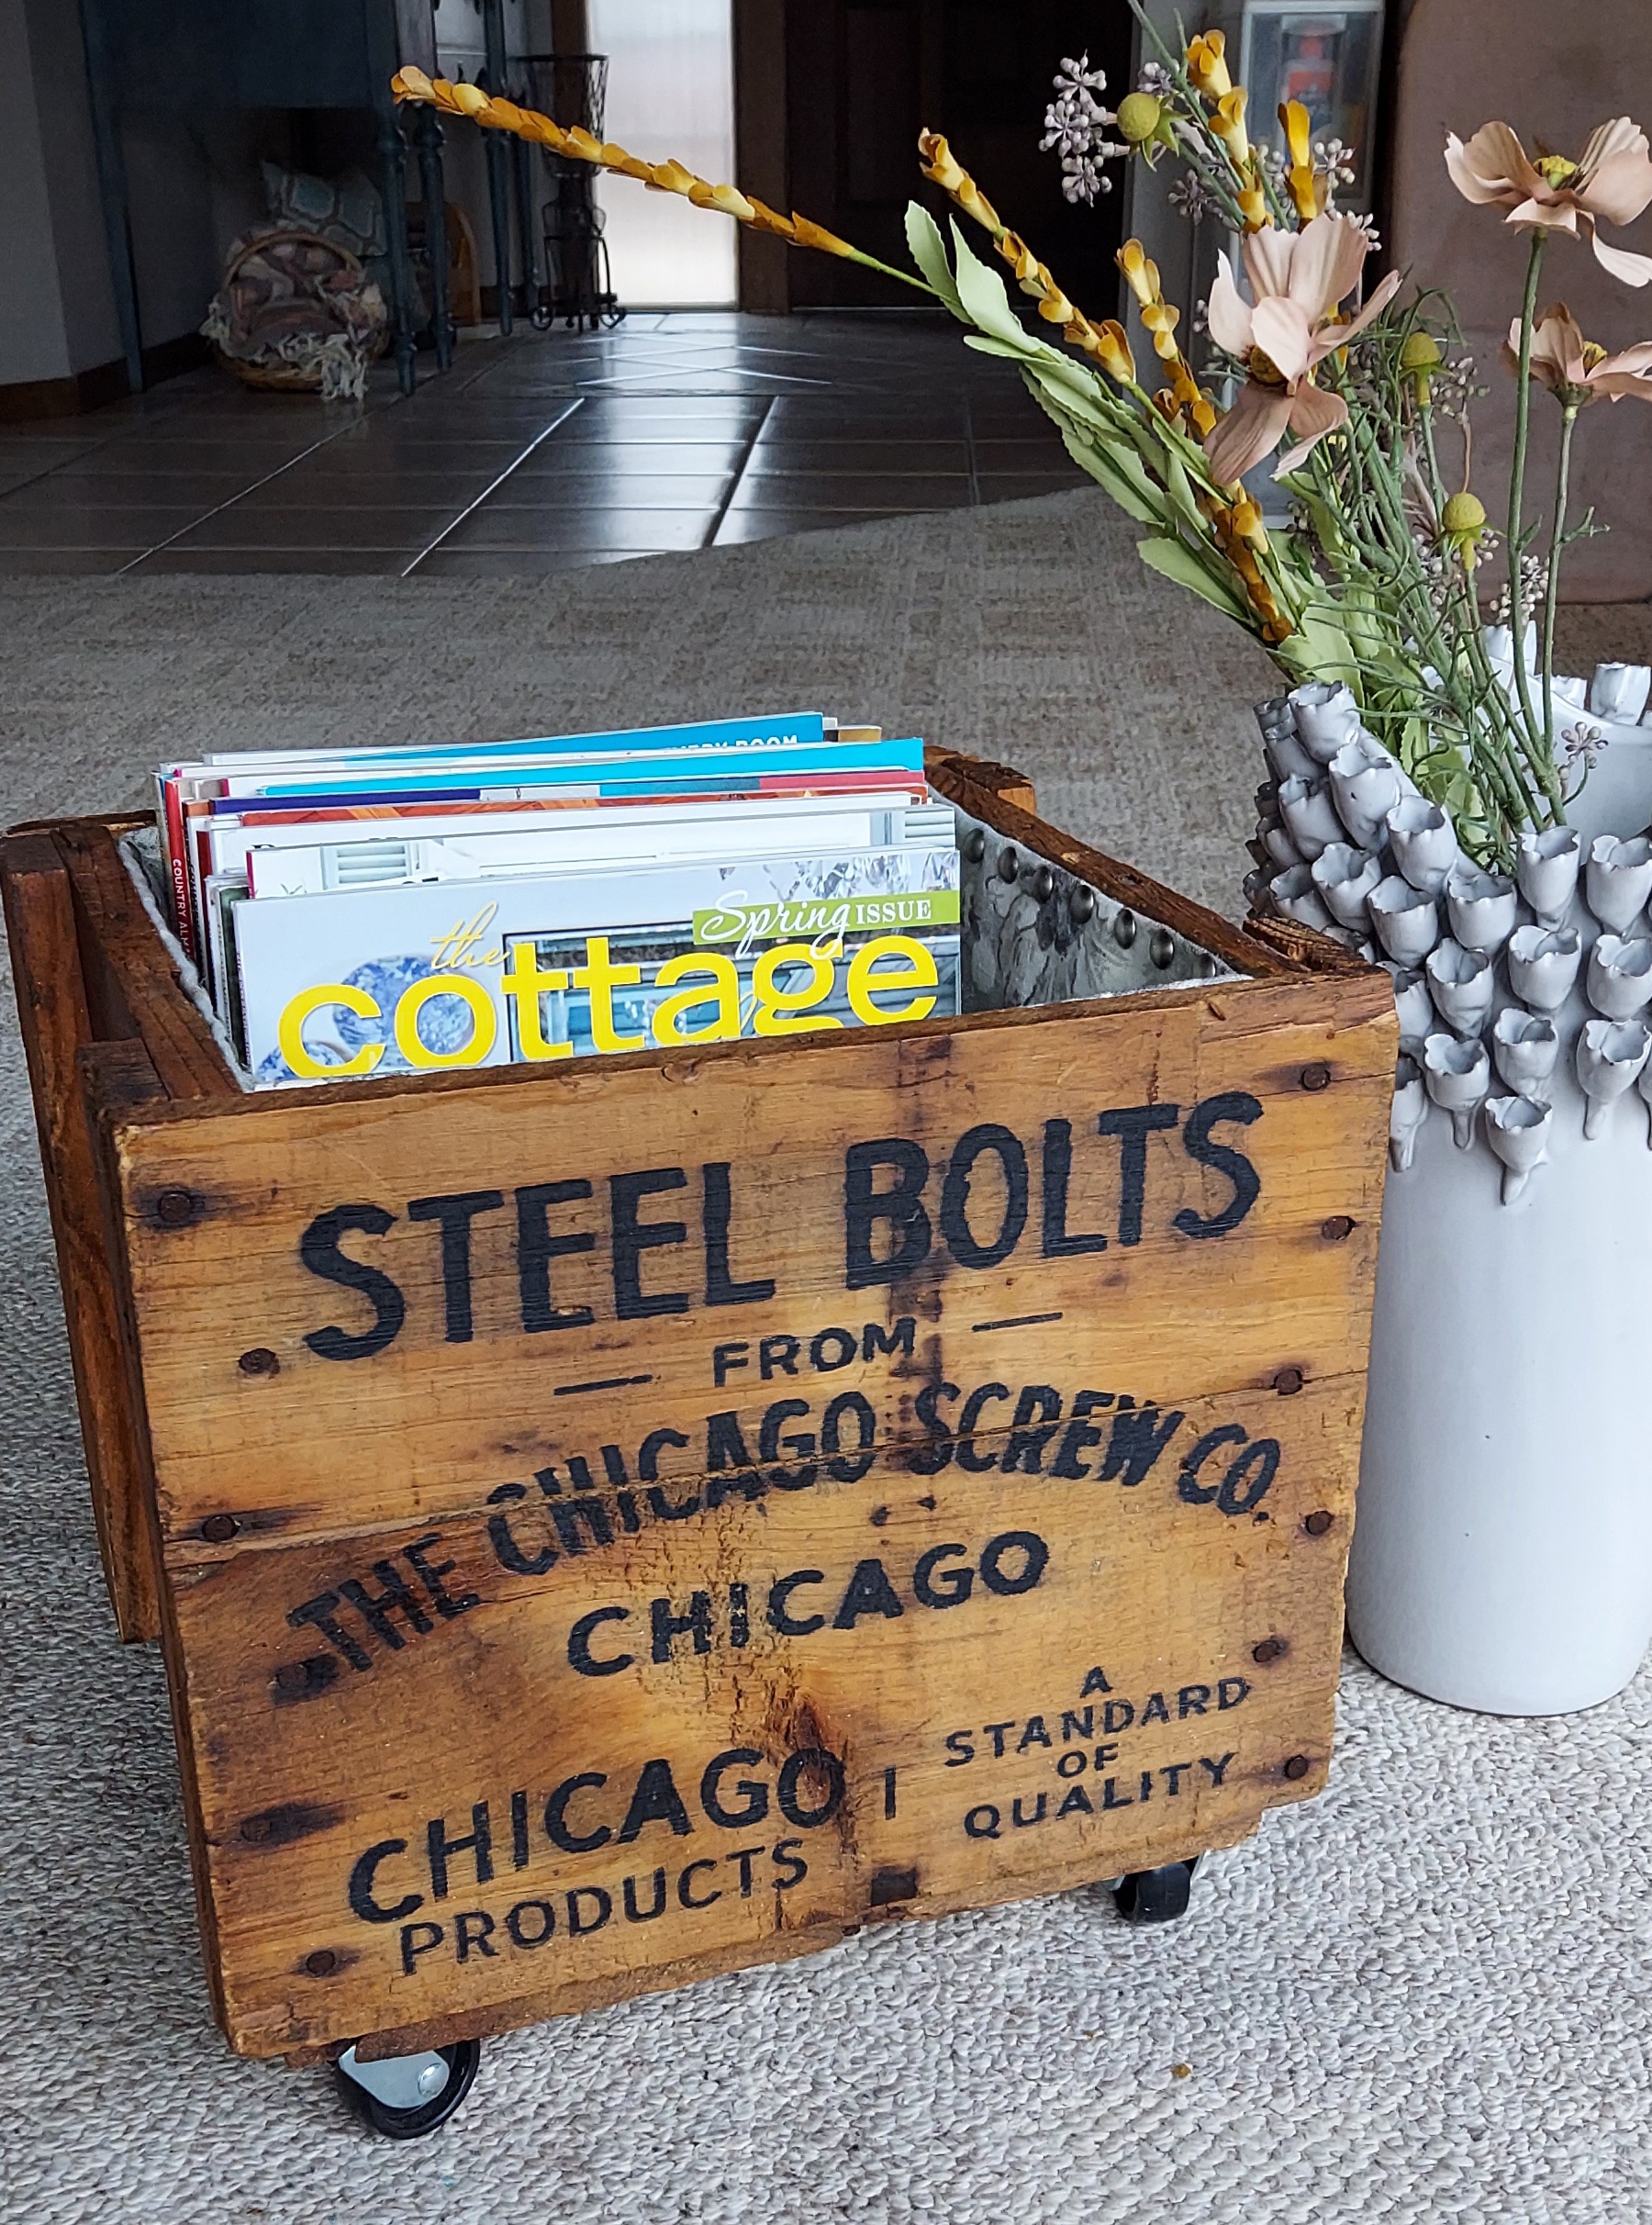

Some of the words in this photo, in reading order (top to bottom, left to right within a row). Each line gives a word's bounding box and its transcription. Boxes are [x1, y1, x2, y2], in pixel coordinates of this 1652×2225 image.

[173, 858, 187, 918] COUNTRY
[700, 889, 849, 960] Spring
[855, 900, 932, 925] ISSUE
[430, 900, 510, 969] the
[278, 934, 939, 1079] cottage
[301, 1161, 776, 1360] STEEL
[844, 1090, 1264, 1291] BOLTS
[713, 1316, 916, 1388] FROM
[285, 1532, 480, 1672] THE
[486, 1391, 876, 1576] CHICAGO
[908, 1381, 1186, 1486] SCREW
[567, 1530, 1050, 1677] CHICAGO
[944, 1676, 1252, 1767] STANDARD
[1079, 1666, 1113, 1698] A
[964, 1751, 1237, 1839] QUALITY
[1056, 1742, 1119, 1779] OF
[348, 1748, 847, 1924] CHICAGO
[399, 1837, 809, 1976] PRODUCTS
